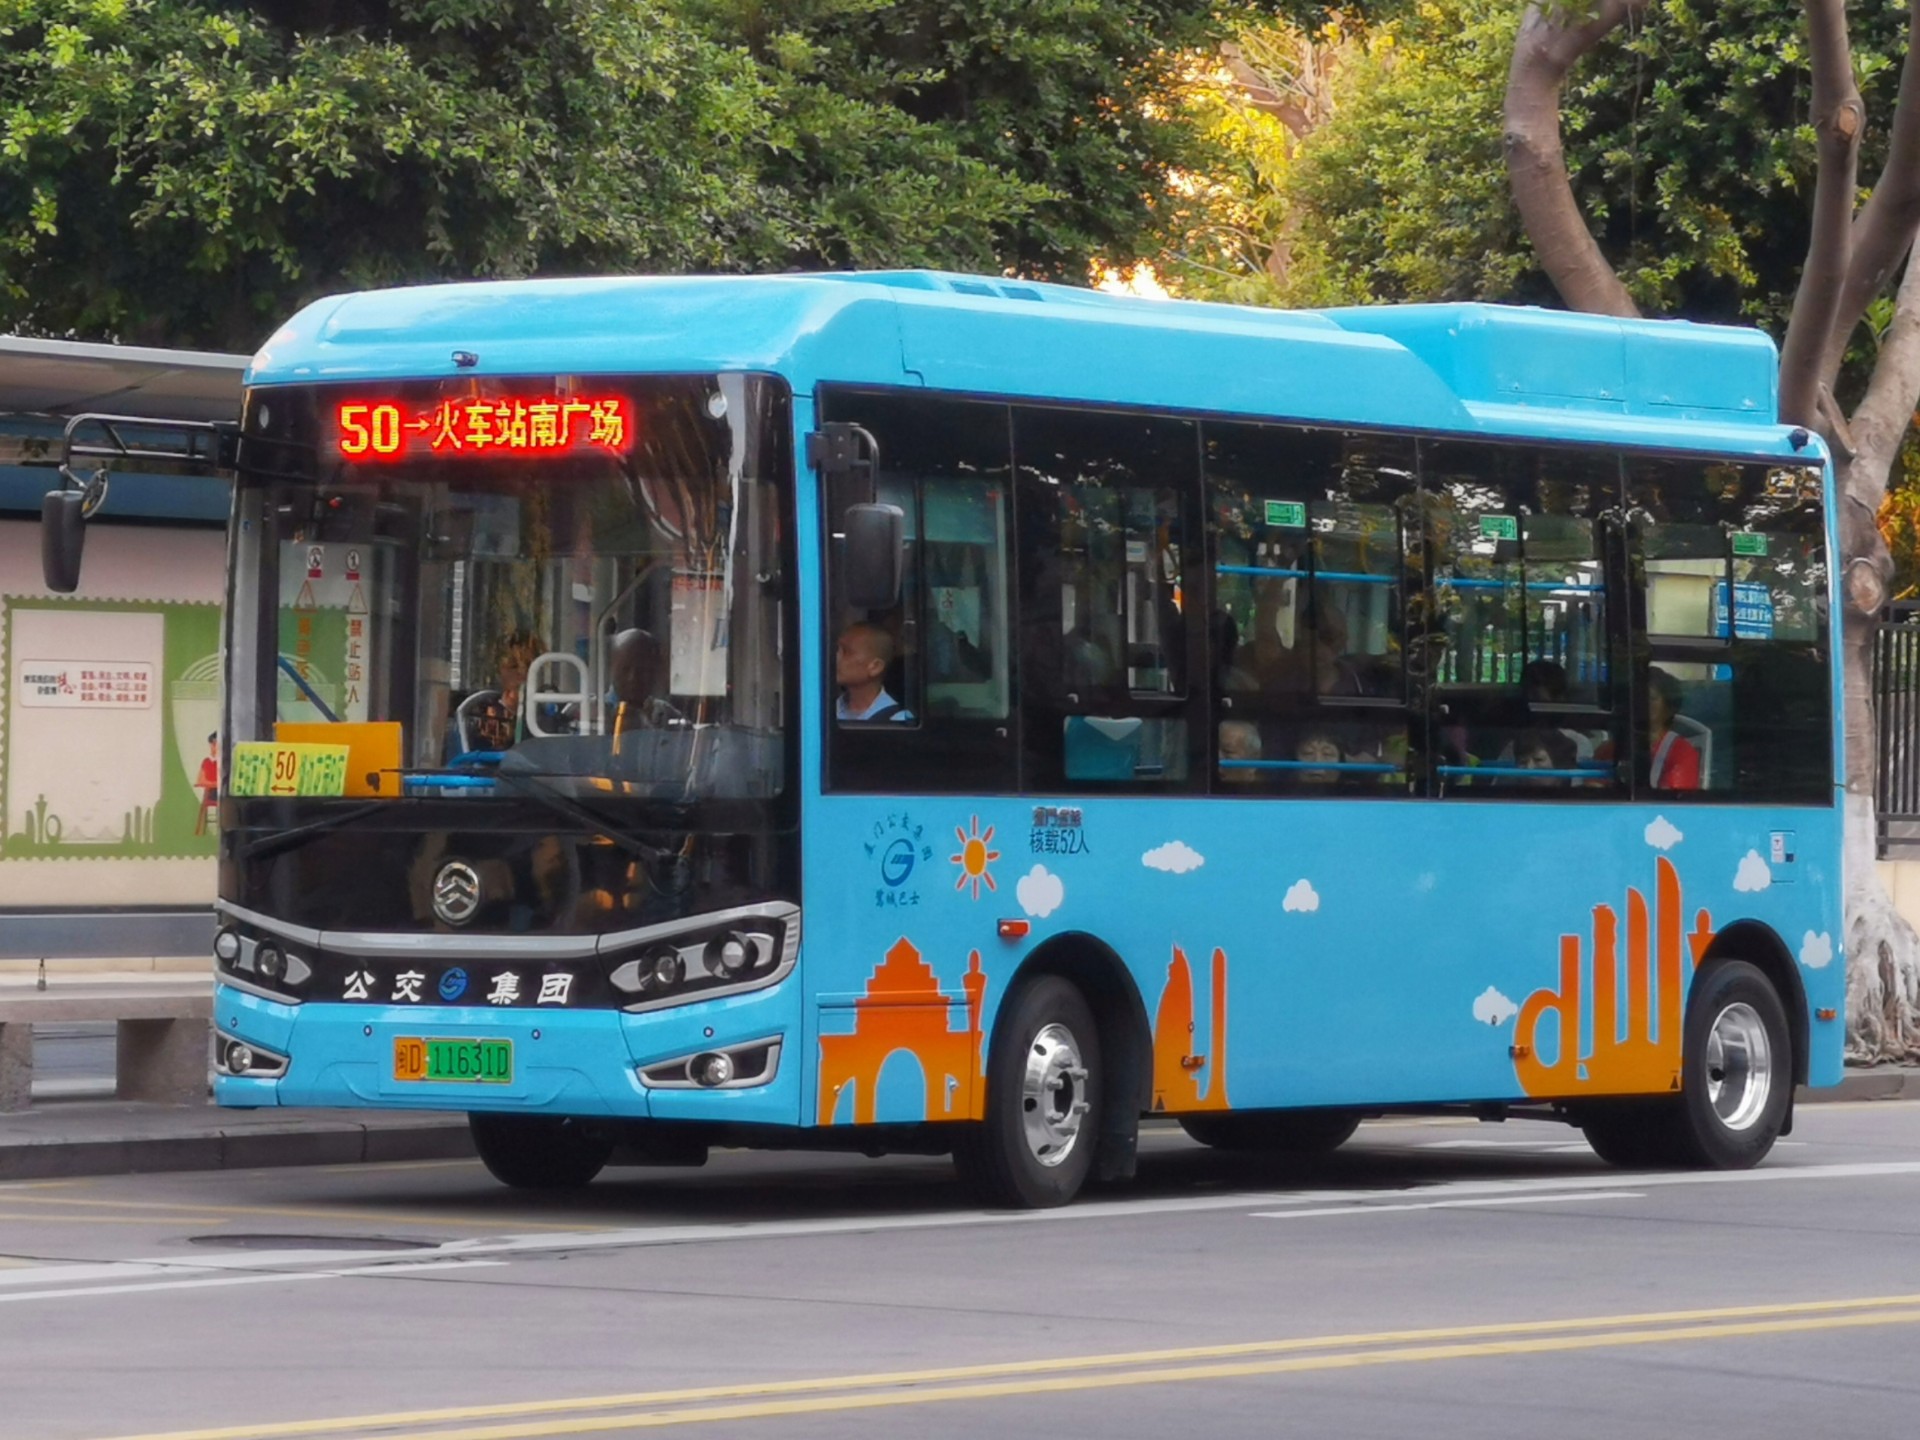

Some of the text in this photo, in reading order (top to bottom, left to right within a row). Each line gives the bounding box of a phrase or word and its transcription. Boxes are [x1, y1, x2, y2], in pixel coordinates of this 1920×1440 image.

[341, 399, 624, 453] 50 火车站南广场
[275, 751, 296, 781] 50
[1029, 828, 1090, 854] 核载52人
[343, 970, 426, 1002] 公交
[486, 971, 574, 1004] 集团
